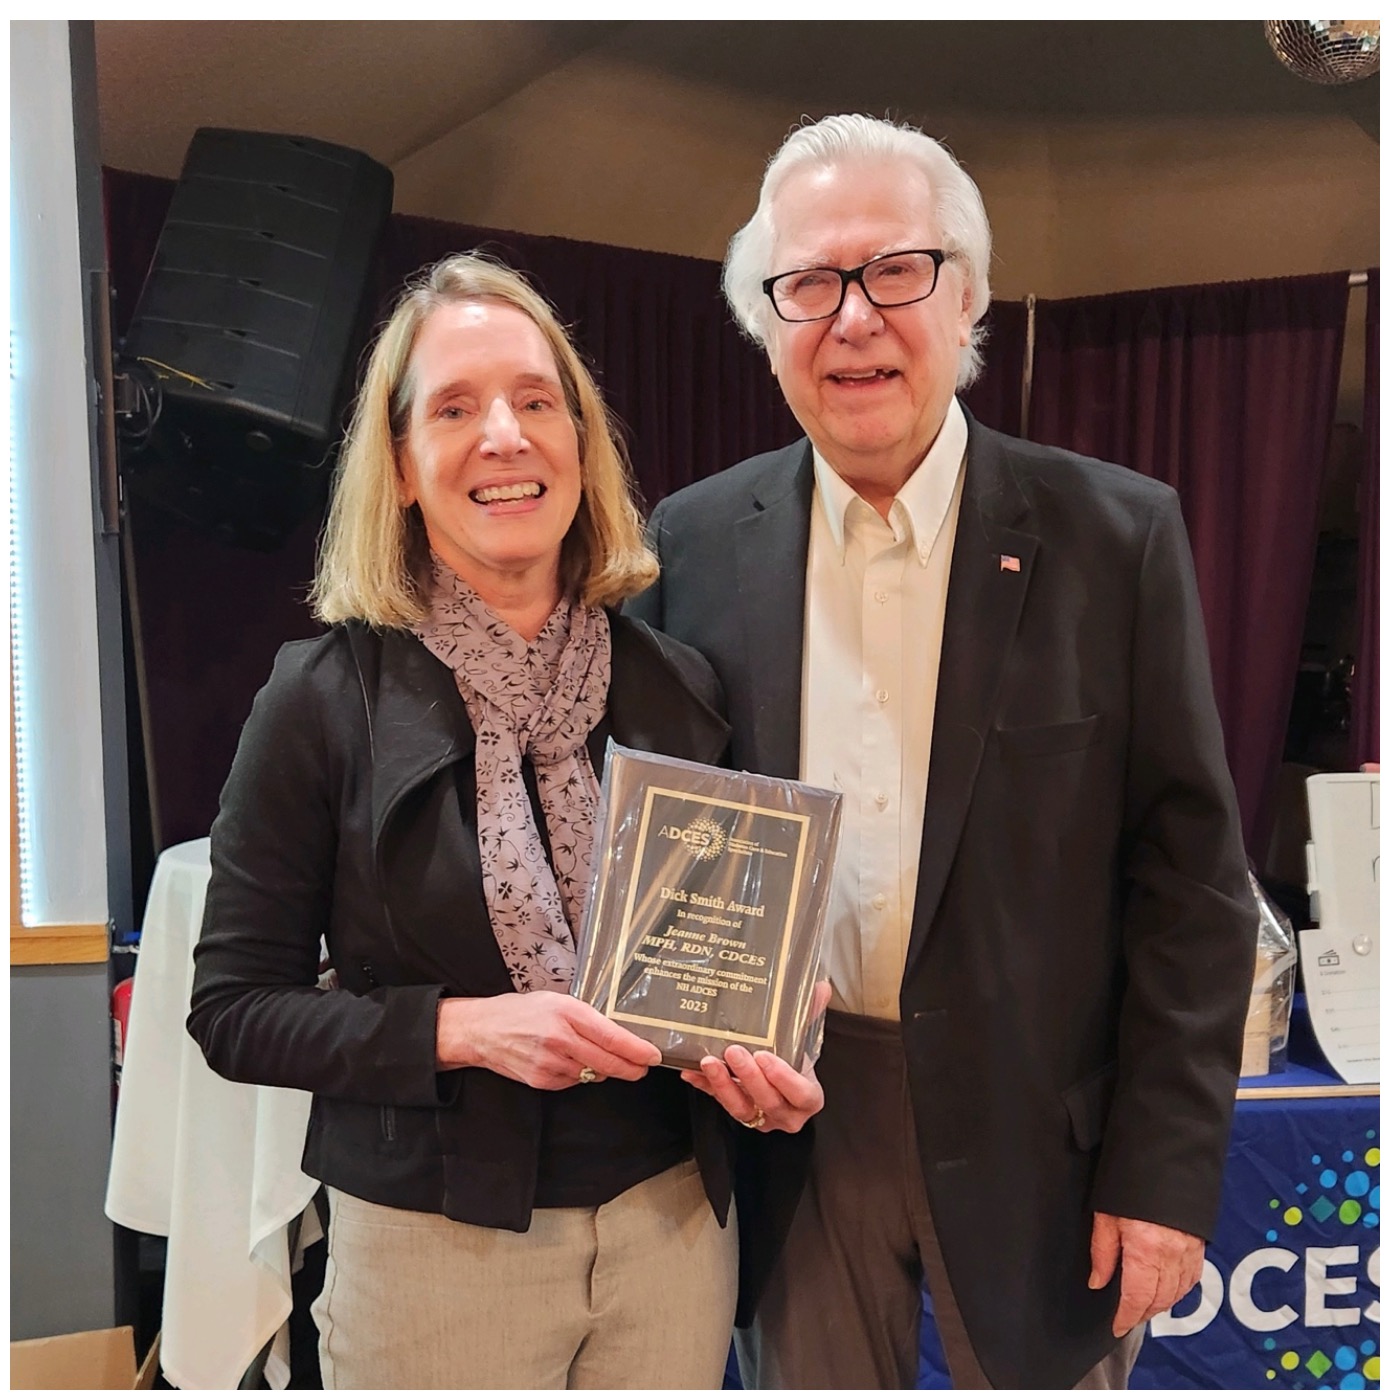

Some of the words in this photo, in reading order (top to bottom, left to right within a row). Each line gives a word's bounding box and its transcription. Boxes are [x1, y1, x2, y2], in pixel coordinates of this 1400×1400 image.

[658, 825, 712, 846] ADCES
[660, 887, 688, 903] Dick
[690, 893, 724, 910] Smith
[727, 900, 765, 917] Award
[677, 909, 686, 918] In
[687, 912, 731, 927] recognition
[732, 920, 743, 929] of
[663, 925, 706, 941] Jeanne
[708, 933, 747, 949] Brown
[642, 935, 677, 951] MPH,
[680, 942, 715, 958] RDN,
[718, 950, 767, 967] CDCES
[634, 952, 661, 965] Whose
[662, 960, 716, 976] extraordinary
[716, 969, 768, 985] commitment
[643, 966, 681, 980] enhances
[682, 973, 696, 982] the
[697, 975, 729, 989] mission
[730, 981, 739, 990] of
[739, 983, 753, 993] the
[676, 982, 689, 991] NH
[690, 984, 718, 997] ADCES
[680, 998, 708, 1013] 2023
